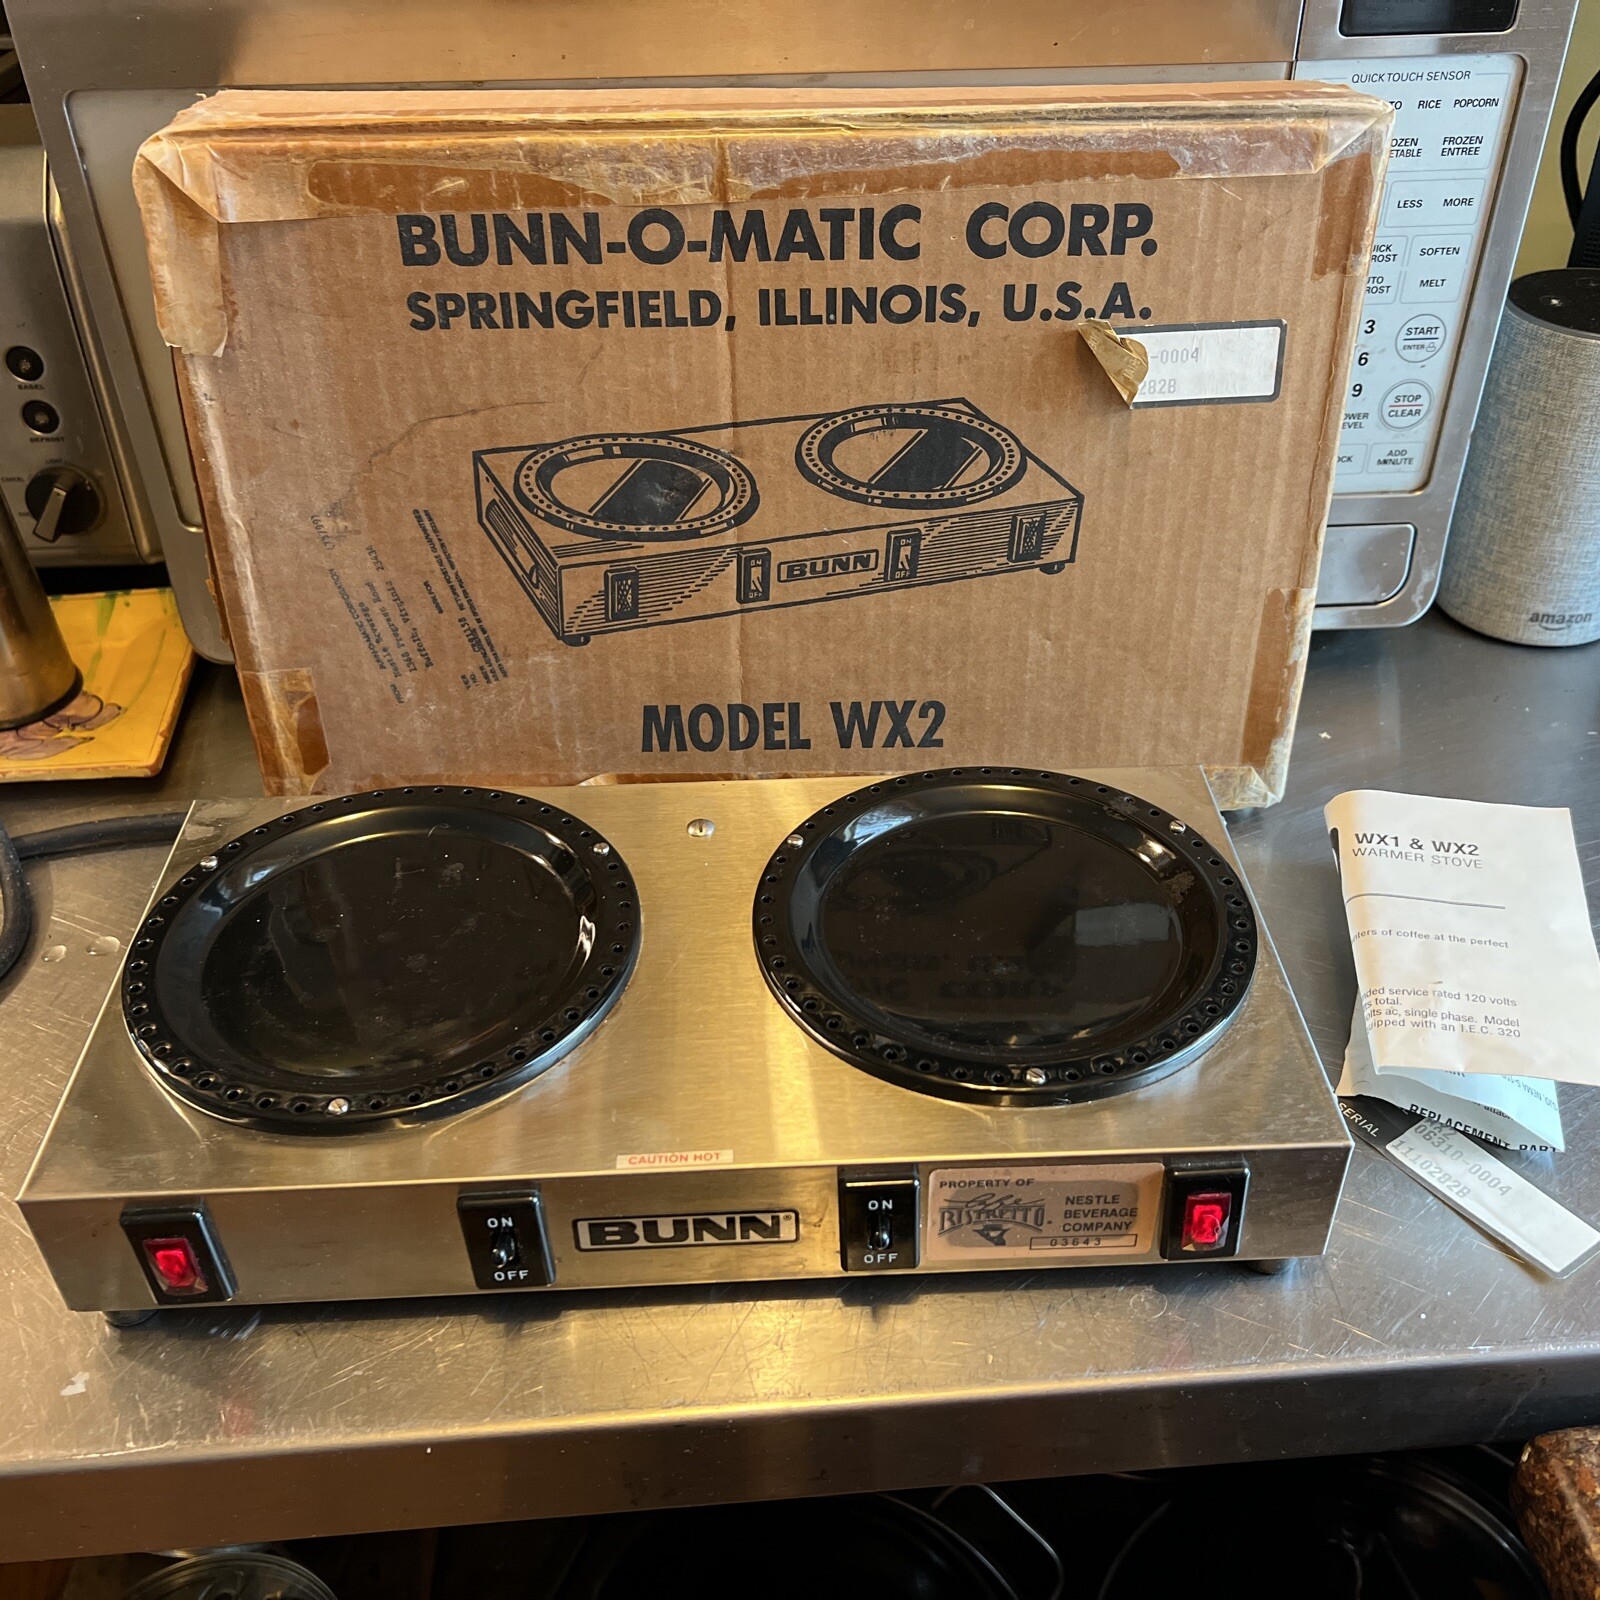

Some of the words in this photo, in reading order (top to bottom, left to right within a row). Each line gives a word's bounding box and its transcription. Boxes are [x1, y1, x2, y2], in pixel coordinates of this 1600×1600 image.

[1351, 73, 1385, 84] QUICK
[1386, 72, 1424, 82] TOUCH
[1426, 70, 1471, 81] SENSOR
[1417, 99, 1442, 109] RICE
[1453, 97, 1500, 108] POPCORN
[1391, 138, 1419, 147] OZEN
[1442, 135, 1484, 145] FROZEN
[1389, 149, 1422, 158] ETABLE
[1440, 146, 1481, 157] ENTREE
[1397, 199, 1423, 209] LESS
[1442, 197, 1474, 208] MORE
[396, 203, 921, 267] BUNN-O-MATIC
[966, 201, 1158, 260] CORP.
[1419, 246, 1460, 257] SOFTEN
[1371, 253, 1398, 263] ROST
[1419, 278, 1446, 288] MELT
[407, 289, 735, 332] SPRINGFIELD,
[758, 283, 980, 327] ILLINOIS,
[1004, 281, 1152, 322] U.S.A.
[1364, 319, 1376, 334] 3
[1405, 326, 1440, 336] START
[1402, 343, 1426, 351] ENTER
[1150, 347, 1199, 364] -0004
[1357, 352, 1369, 366] 6
[1351, 383, 1363, 398] 9
[1394, 394, 1422, 403] STOP
[1388, 409, 1422, 418] CLEAR
[1342, 421, 1364, 430] EVEL
[1387, 449, 1408, 457] ADD
[1376, 457, 1414, 466] MINUTE
[786, 553, 871, 579] BUNN
[895, 570, 911, 579] OFF
[1529, 611, 1593, 625] amazon
[641, 702, 812, 752] MODEL
[829, 700, 947, 749] WX2
[1354, 833, 1400, 847] WX1
[1409, 838, 1424, 850] &
[1431, 840, 1480, 856] WX2
[1352, 847, 1425, 863] WARMER
[1430, 854, 1483, 869] STOVE
[1396, 929, 1430, 940] coffee
[1433, 934, 1445, 942] at
[1448, 934, 1466, 944] the
[1470, 938, 1509, 949] perfect
[1375, 997, 1402, 1006] total.
[1388, 987, 1429, 997] service
[1432, 989, 1461, 1000] rated
[1465, 993, 1486, 1003] 120
[1489, 997, 1517, 1007] volts
[1385, 1008, 1402, 1017] ac,
[1404, 1008, 1438, 1019] single
[1441, 1011, 1478, 1024] phase.
[1484, 1015, 1520, 1027] Model
[1411, 1019, 1436, 1030] with
[1441, 1023, 1456, 1032] an
[1461, 1024, 1493, 1035] I.E.C.
[1497, 1027, 1521, 1038] 320
[1338, 1102, 1380, 1137] SERIAL
[628, 1153, 689, 1165] CAUTION
[692, 1151, 722, 1162] HOT
[1414, 1124, 1513, 1196] 06310-0004
[939, 1178, 1011, 1188] PROPERTY
[1015, 1178, 1035, 1187] OF
[868, 1199, 893, 1211] ON
[1065, 1194, 1120, 1206] NESTLE
[1063, 1207, 1139, 1219] BEVERAGE
[486, 1216, 514, 1229] ON
[1062, 1221, 1132, 1233] COMPANY
[587, 1214, 781, 1246] BUNN
[1049, 1238, 1102, 1248] 03643
[863, 1252, 898, 1265] OFF
[493, 1269, 530, 1282] OFF
